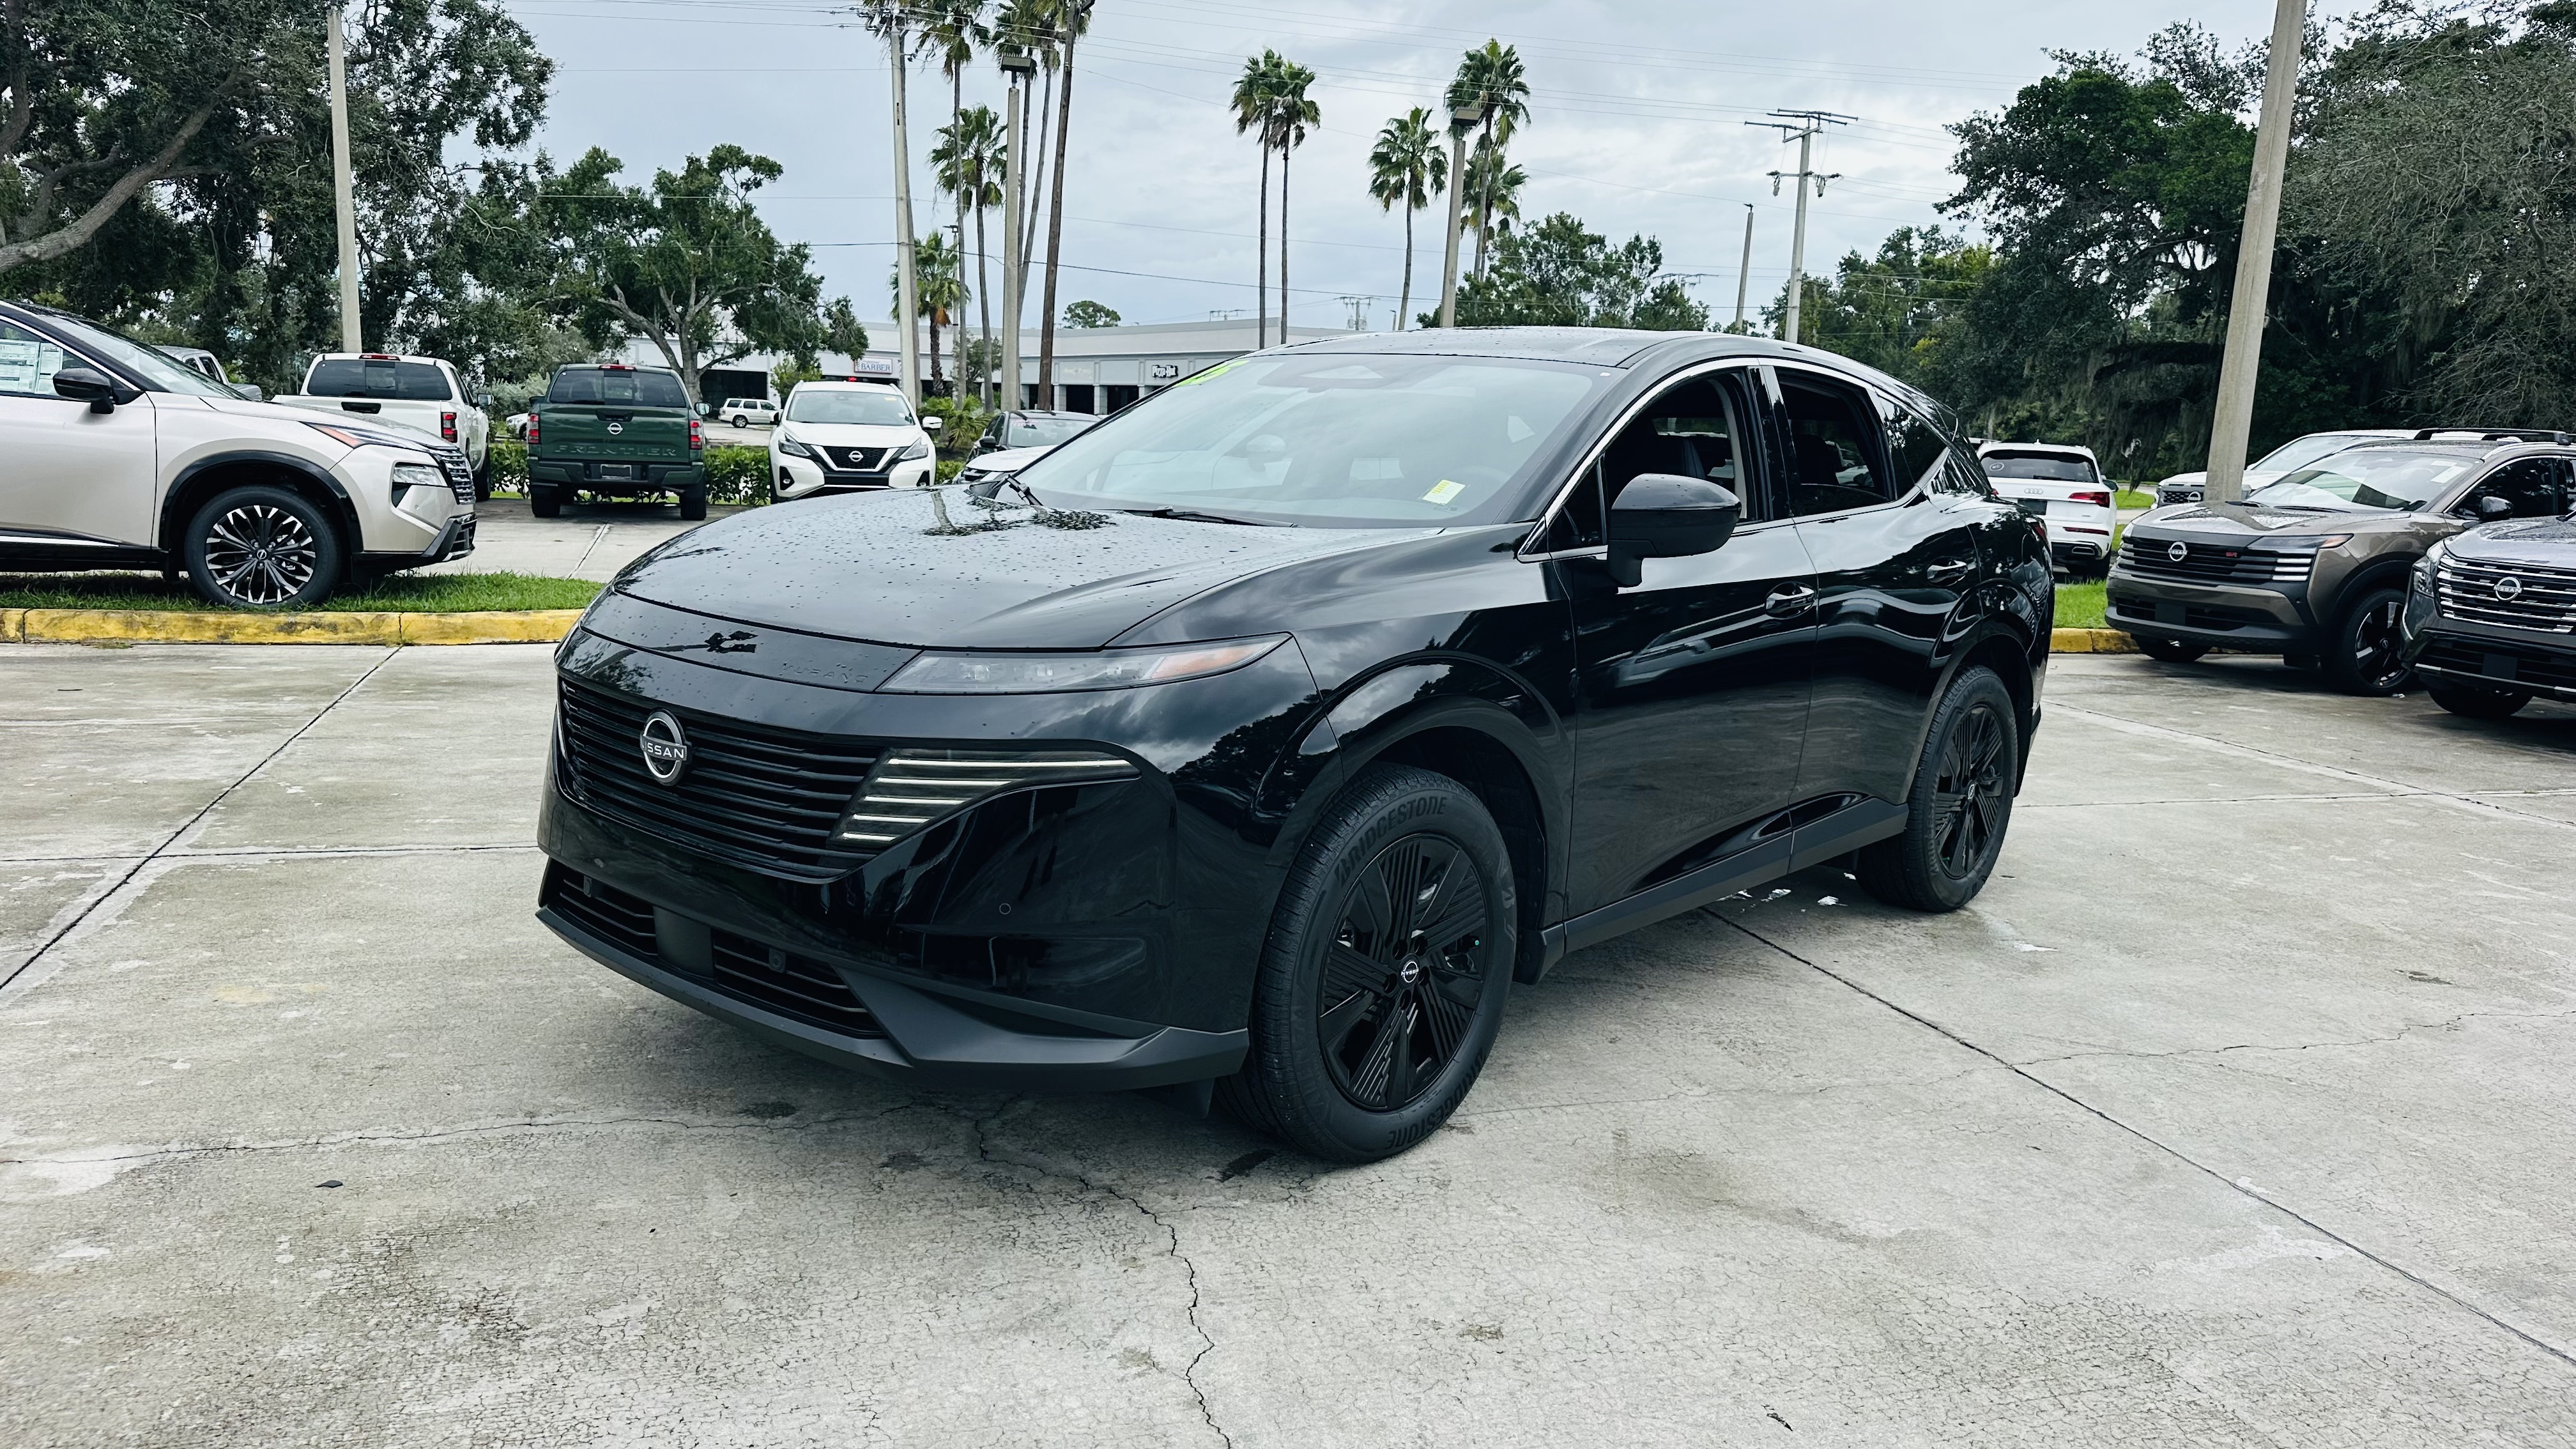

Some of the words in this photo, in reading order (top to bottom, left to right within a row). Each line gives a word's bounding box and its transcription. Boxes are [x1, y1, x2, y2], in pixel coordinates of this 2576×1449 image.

[1152, 365, 1167, 378] Pizza
[1166, 365, 1177, 377] Hut
[555, 445, 677, 456] FRONTIER
[1333, 796, 1448, 888] BRIDGESTONE
